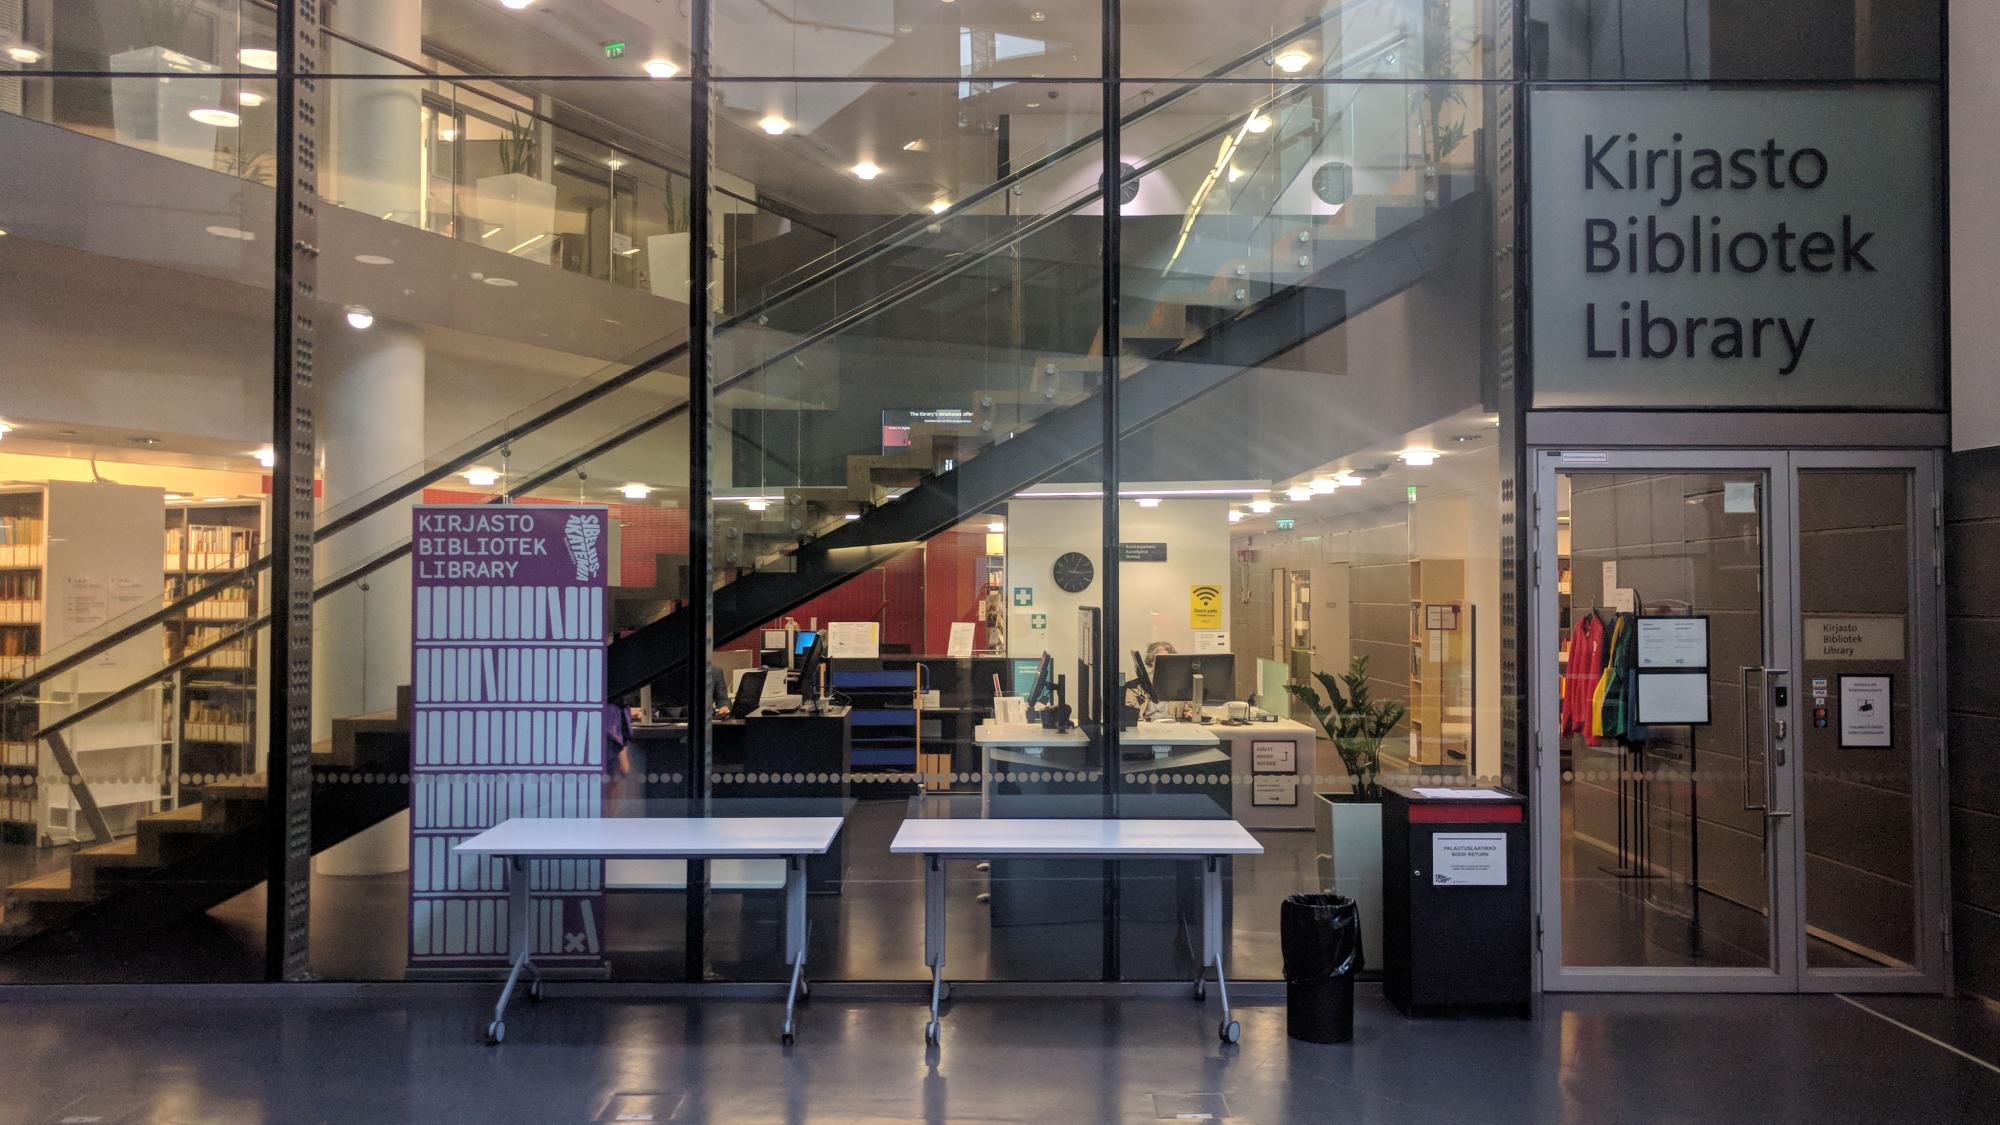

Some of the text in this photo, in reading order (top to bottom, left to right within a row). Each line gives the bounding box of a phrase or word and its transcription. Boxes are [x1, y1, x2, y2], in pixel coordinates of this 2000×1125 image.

[1584, 132, 1829, 207] Kirjasto
[1585, 214, 1878, 274] Bibliotek
[1586, 300, 1816, 376] Library
[418, 514, 535, 533] KIRJASTO
[418, 537, 548, 556] BIBLIOTEK
[564, 514, 590, 582] AKATEMIA
[418, 560, 520, 579] LIBRARY
[1823, 624, 1858, 634] Kirjasto
[1823, 634, 1863, 644] Bibliotek
[1823, 646, 1854, 657] Library
